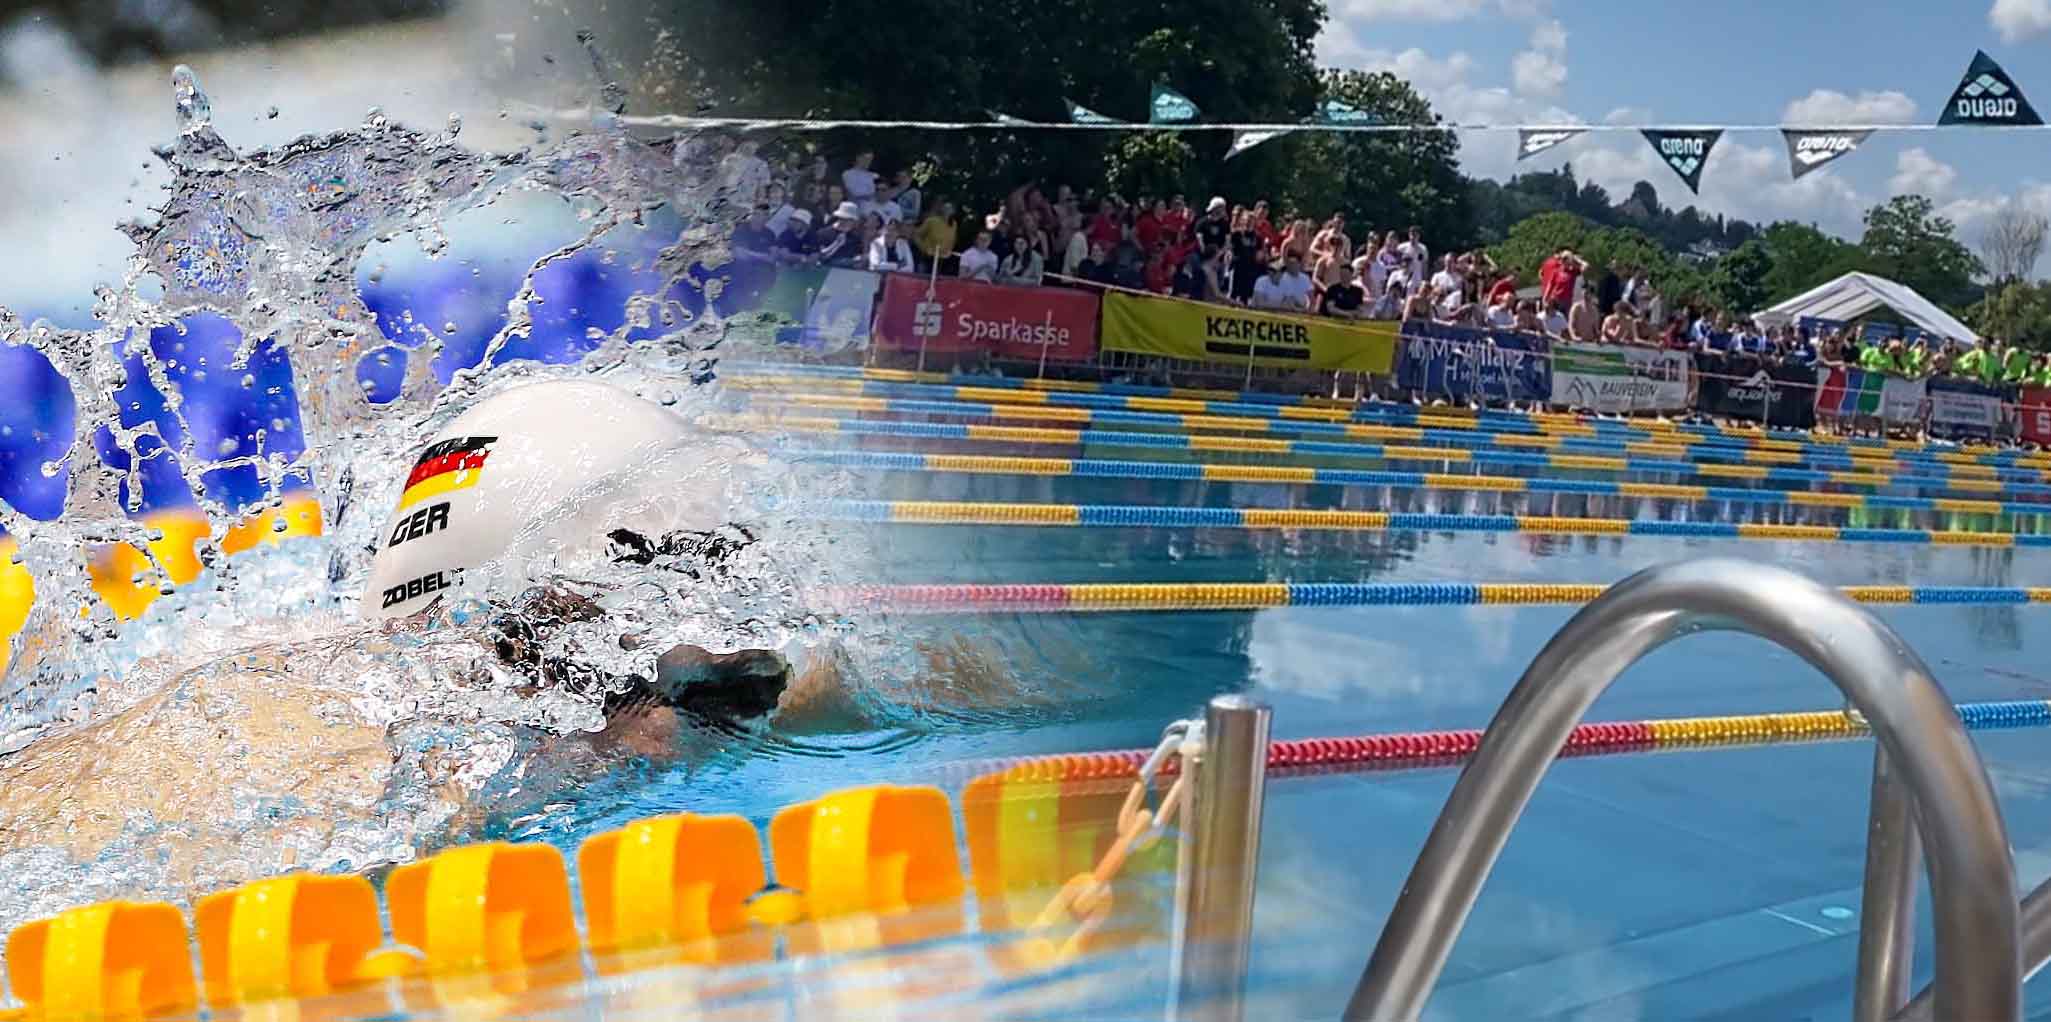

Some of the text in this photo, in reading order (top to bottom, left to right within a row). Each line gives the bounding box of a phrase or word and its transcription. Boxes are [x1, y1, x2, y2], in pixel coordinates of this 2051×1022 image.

[1957, 98, 2017, 118] arena
[1661, 137, 1704, 156] arena
[957, 312, 1071, 346] Sparkasse
[1205, 315, 1311, 343] KÄRCHER
[388, 501, 451, 548] GER
[382, 570, 452, 609] ZOBEL
